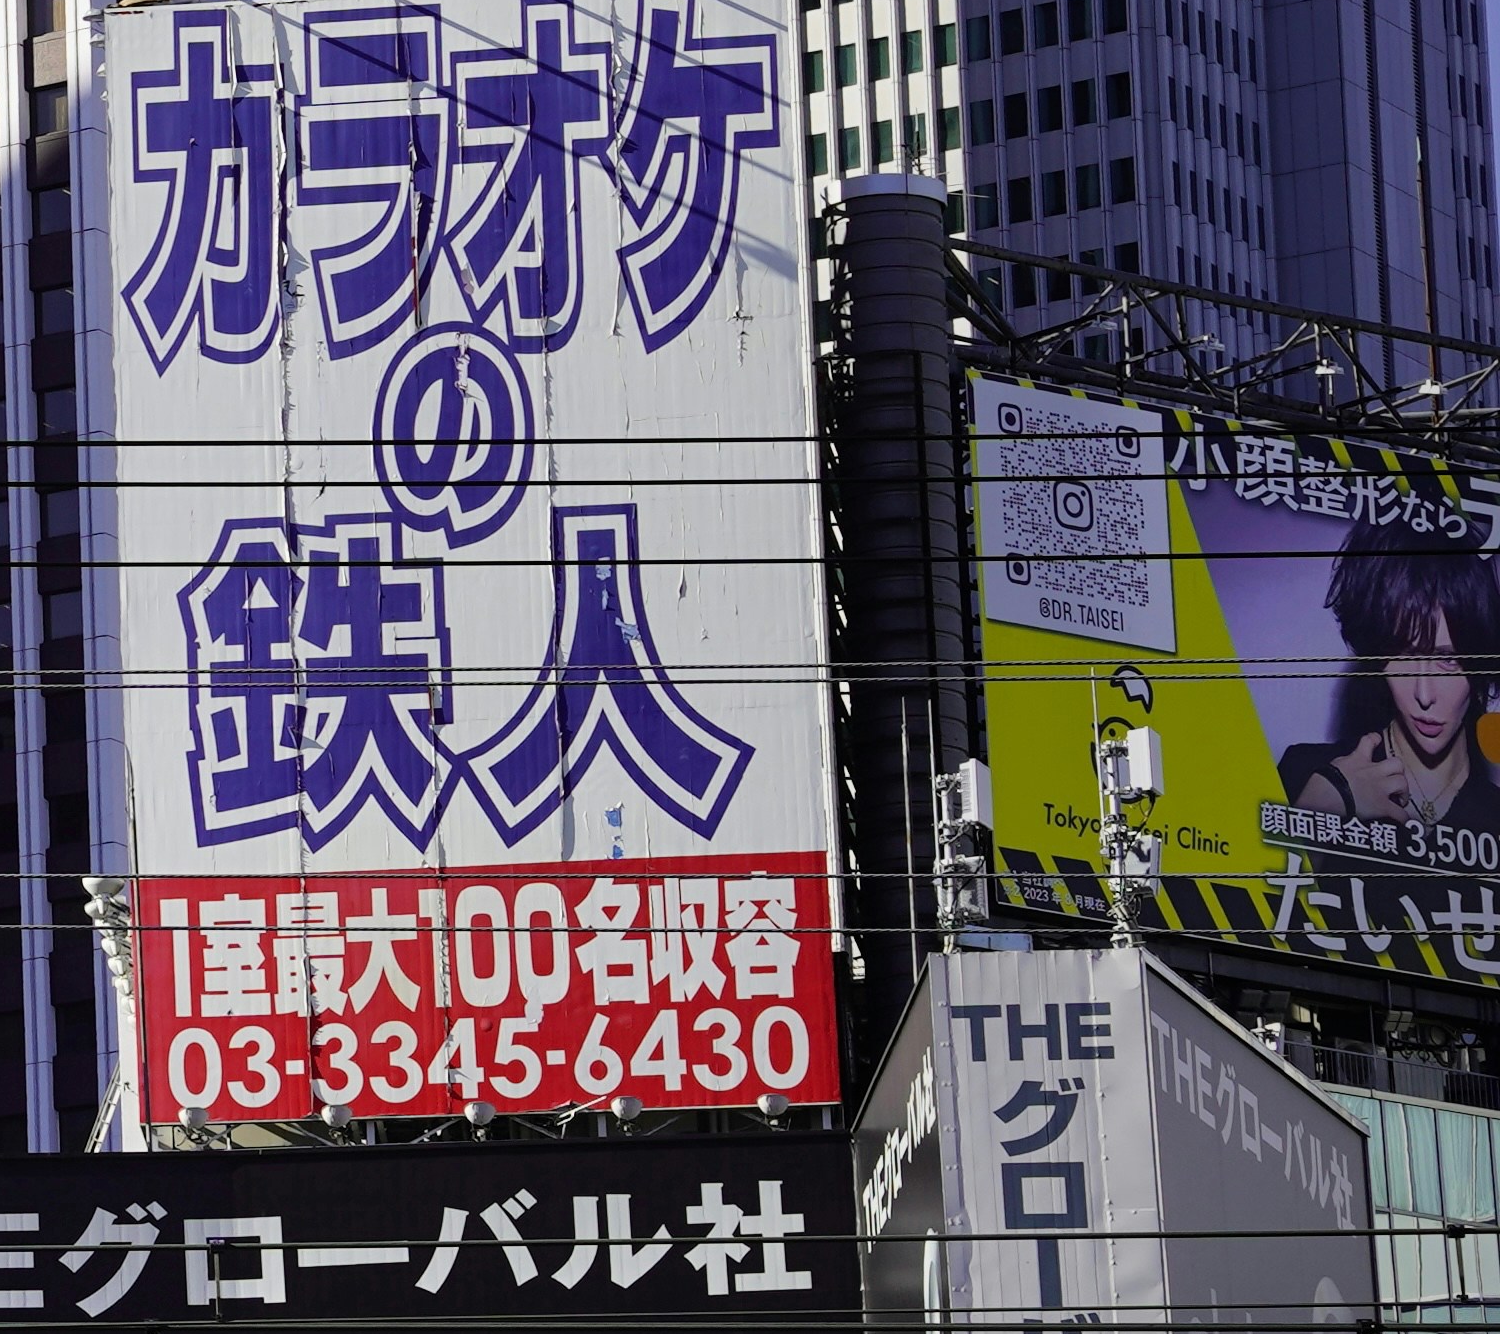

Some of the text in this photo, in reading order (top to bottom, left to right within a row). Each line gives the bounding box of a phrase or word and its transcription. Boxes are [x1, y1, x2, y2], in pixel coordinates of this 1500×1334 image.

[373, 320, 534, 547] の
[1039, 598, 1125, 634] @DR.TAISEI
[176, 503, 757, 853] 鉄人
[1044, 803, 1101, 837] Tokyo
[1177, 827, 1230, 855] Clinic
[1260, 802, 1500, 871] 顔面課金額 3,500
[167, 874, 803, 1020] 1室最大100名収容
[168, 1006, 812, 1110] 03-3345-6430
[952, 1001, 1114, 1063] THE
[1151, 1010, 1357, 1238] THEグローバル社
